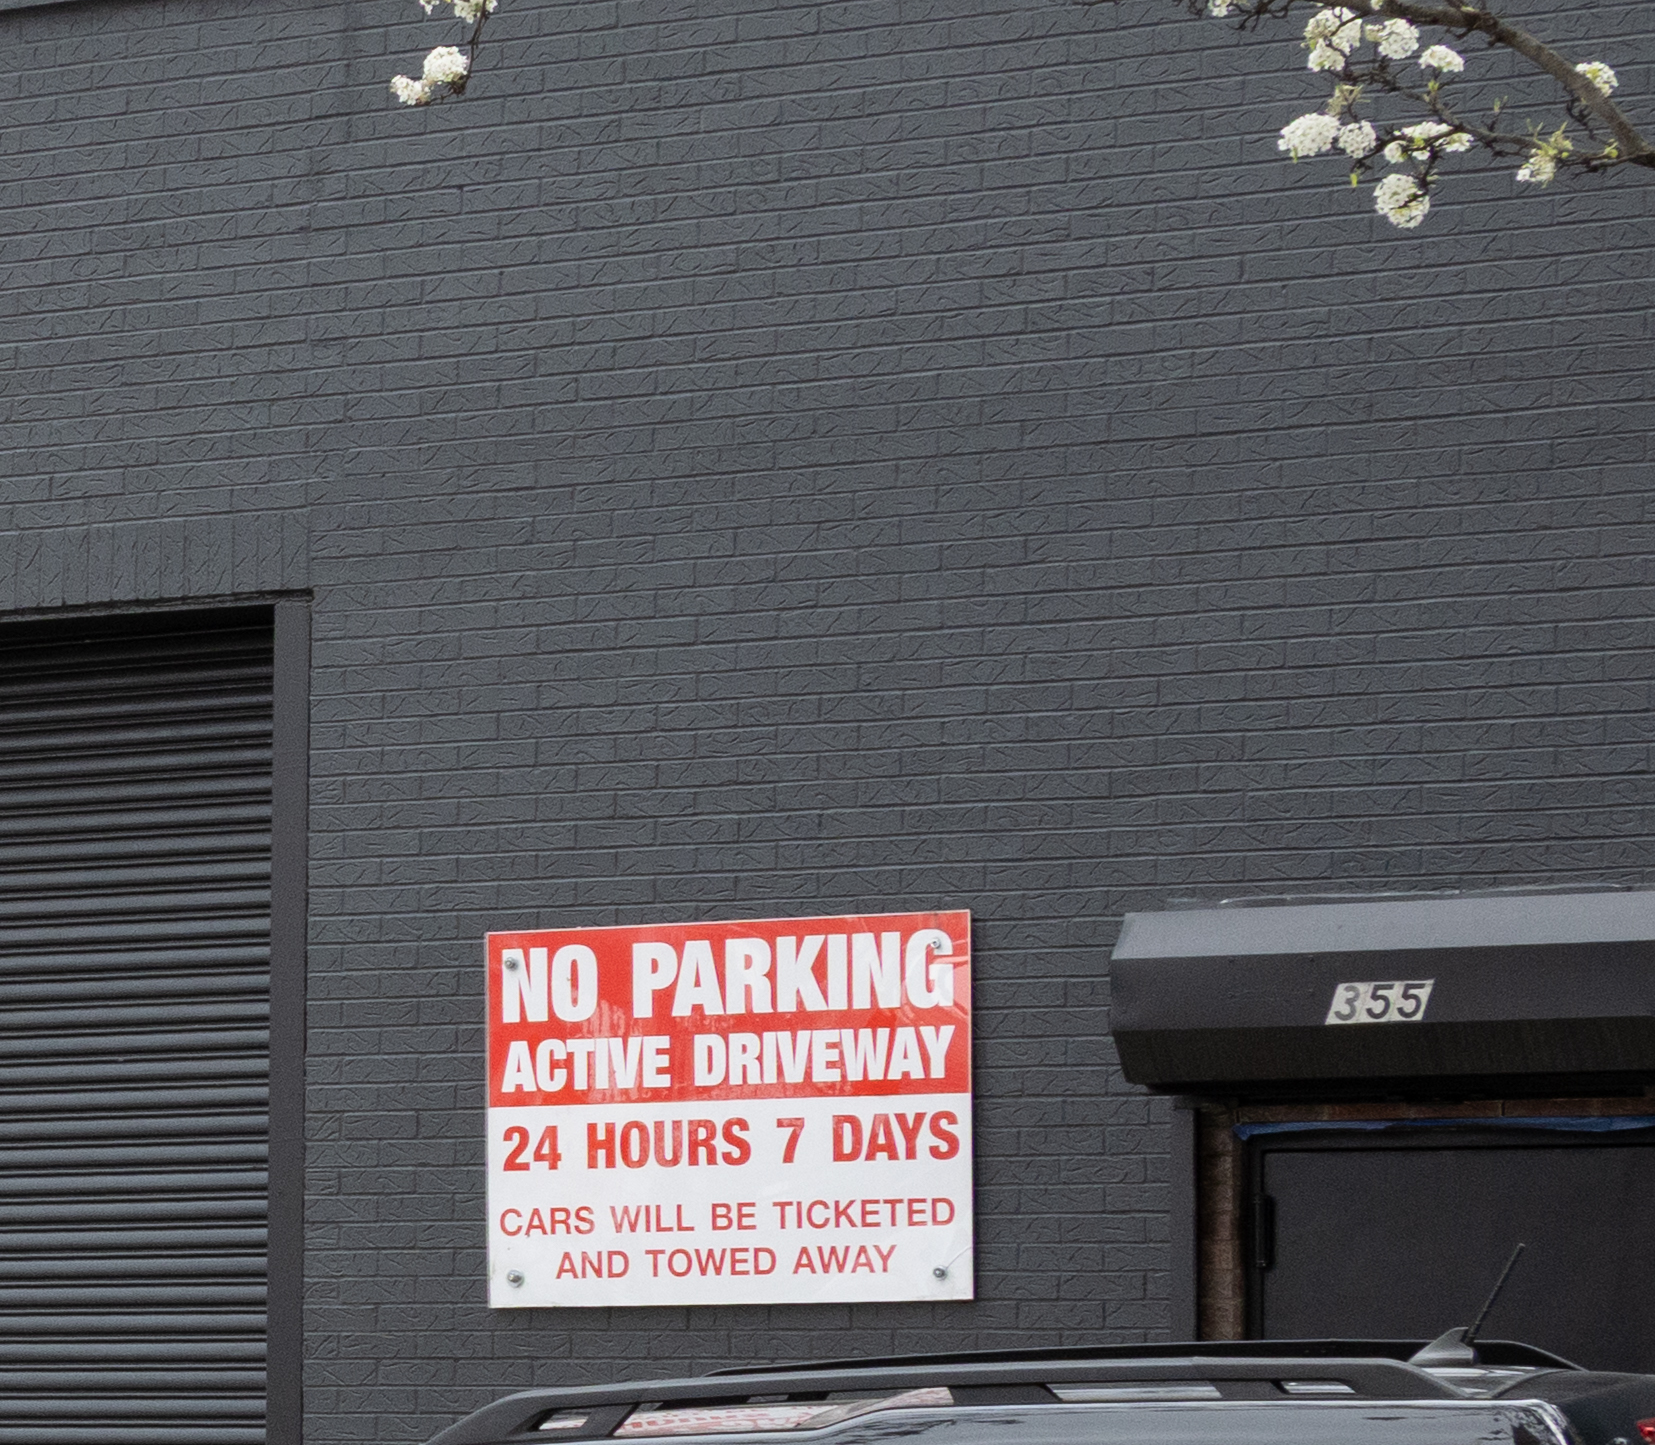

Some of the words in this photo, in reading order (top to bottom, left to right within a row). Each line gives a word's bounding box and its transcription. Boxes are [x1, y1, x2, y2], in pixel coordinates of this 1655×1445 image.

[500, 945, 598, 1023] NO
[631, 928, 955, 1019] PARKING
[1333, 983, 1427, 1021] 355
[501, 1036, 671, 1093] ACTIVE
[693, 1025, 955, 1087] DRIVEWAY
[502, 1125, 562, 1172] 24
[587, 1117, 751, 1169] HOURS
[776, 1117, 805, 1164] 7
[832, 1110, 960, 1163] DAYS
[499, 1206, 595, 1237] CARS
[609, 1203, 694, 1234] WILL
[710, 1202, 758, 1232] BE
[772, 1197, 956, 1230] TICKETED
[555, 1250, 630, 1280] AND
[645, 1246, 777, 1279] TOWED
[792, 1244, 898, 1275] AWAY
